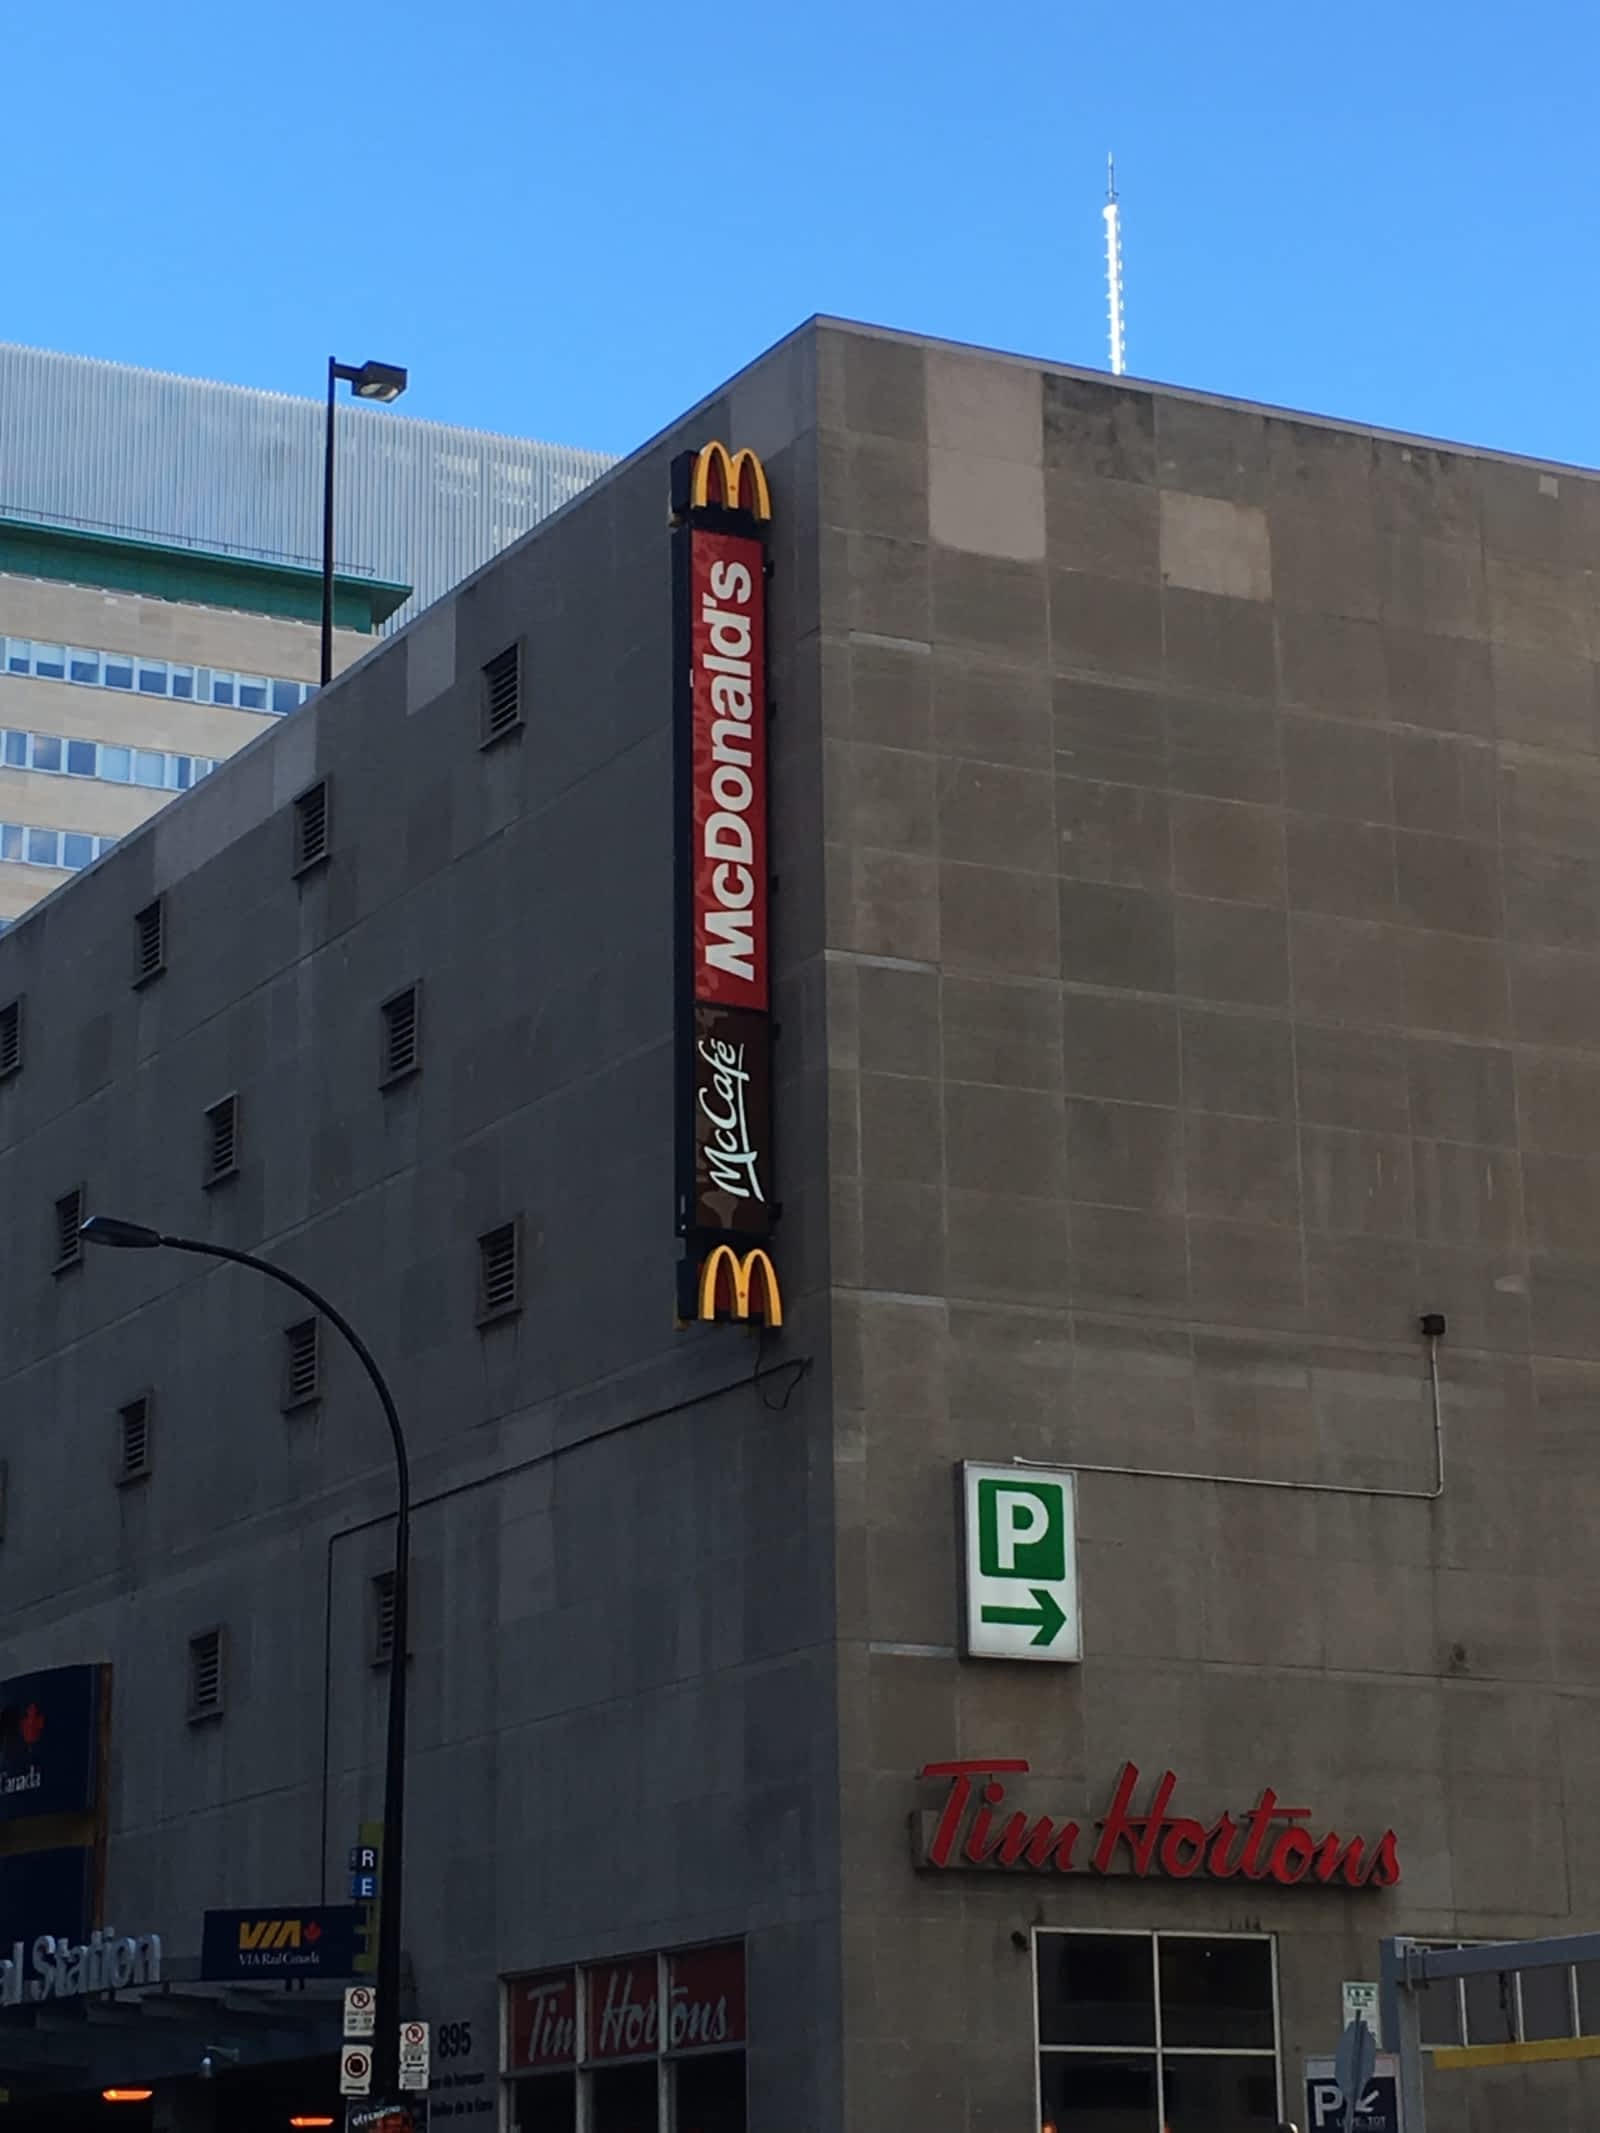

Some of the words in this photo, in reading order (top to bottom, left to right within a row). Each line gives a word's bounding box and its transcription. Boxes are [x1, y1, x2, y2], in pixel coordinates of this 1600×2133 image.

[702, 560, 754, 982] McDonald's
[697, 1037, 767, 1203] McCafé
[996, 1491, 1050, 1570] P
[0, 1763, 41, 1794] Canada
[920, 1758, 1080, 1872] Tim
[1094, 1760, 1401, 1889] Hortons
[361, 1848, 375, 1868] R
[361, 1877, 374, 1897] E
[32, 1925, 161, 2000] Station
[239, 1919, 303, 1951] VIA
[438, 2021, 472, 2058] 895
[527, 1980, 579, 2064] Tim
[1313, 2084, 1344, 2128] P
